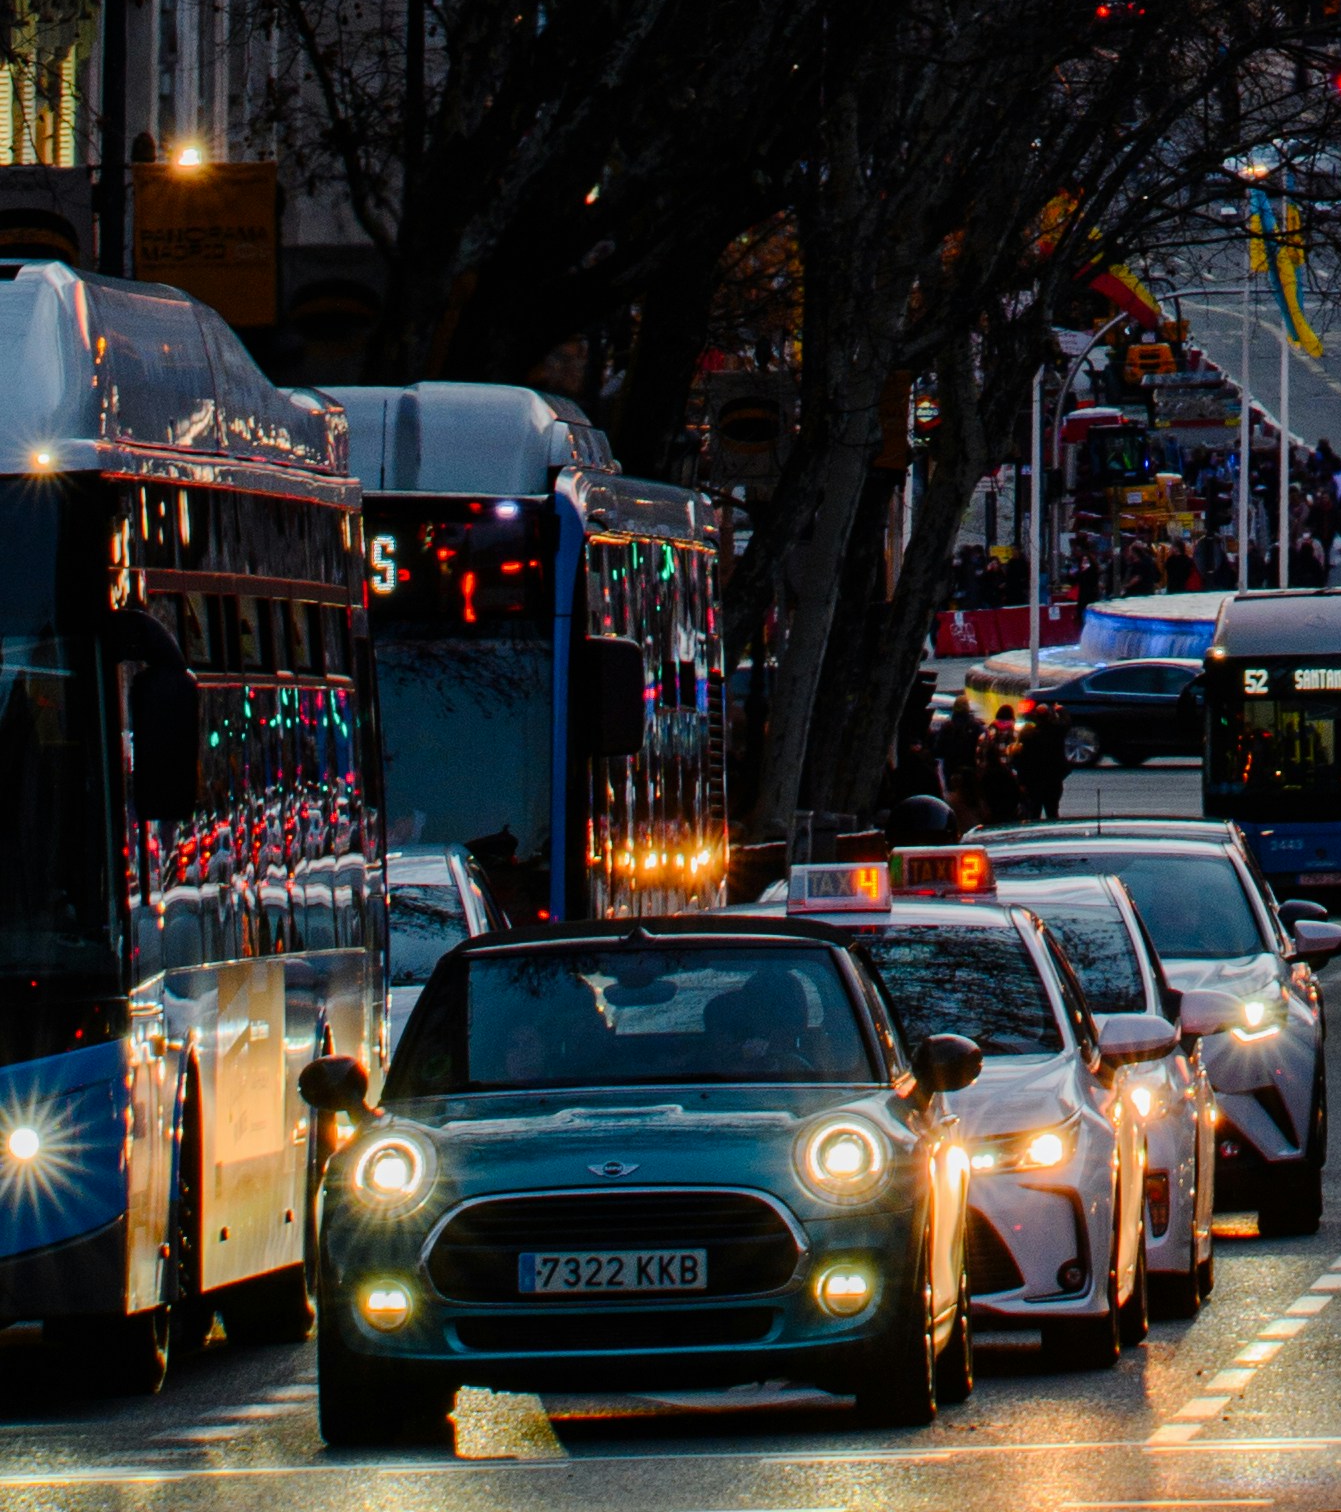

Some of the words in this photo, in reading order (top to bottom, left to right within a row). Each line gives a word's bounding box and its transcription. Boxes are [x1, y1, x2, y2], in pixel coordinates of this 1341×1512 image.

[1244, 668, 1269, 693] 52
[858, 867, 879, 902] 4
[959, 856, 980, 889] 2
[541, 1256, 625, 1289] 7322
[636, 1253, 699, 1287] KKB
